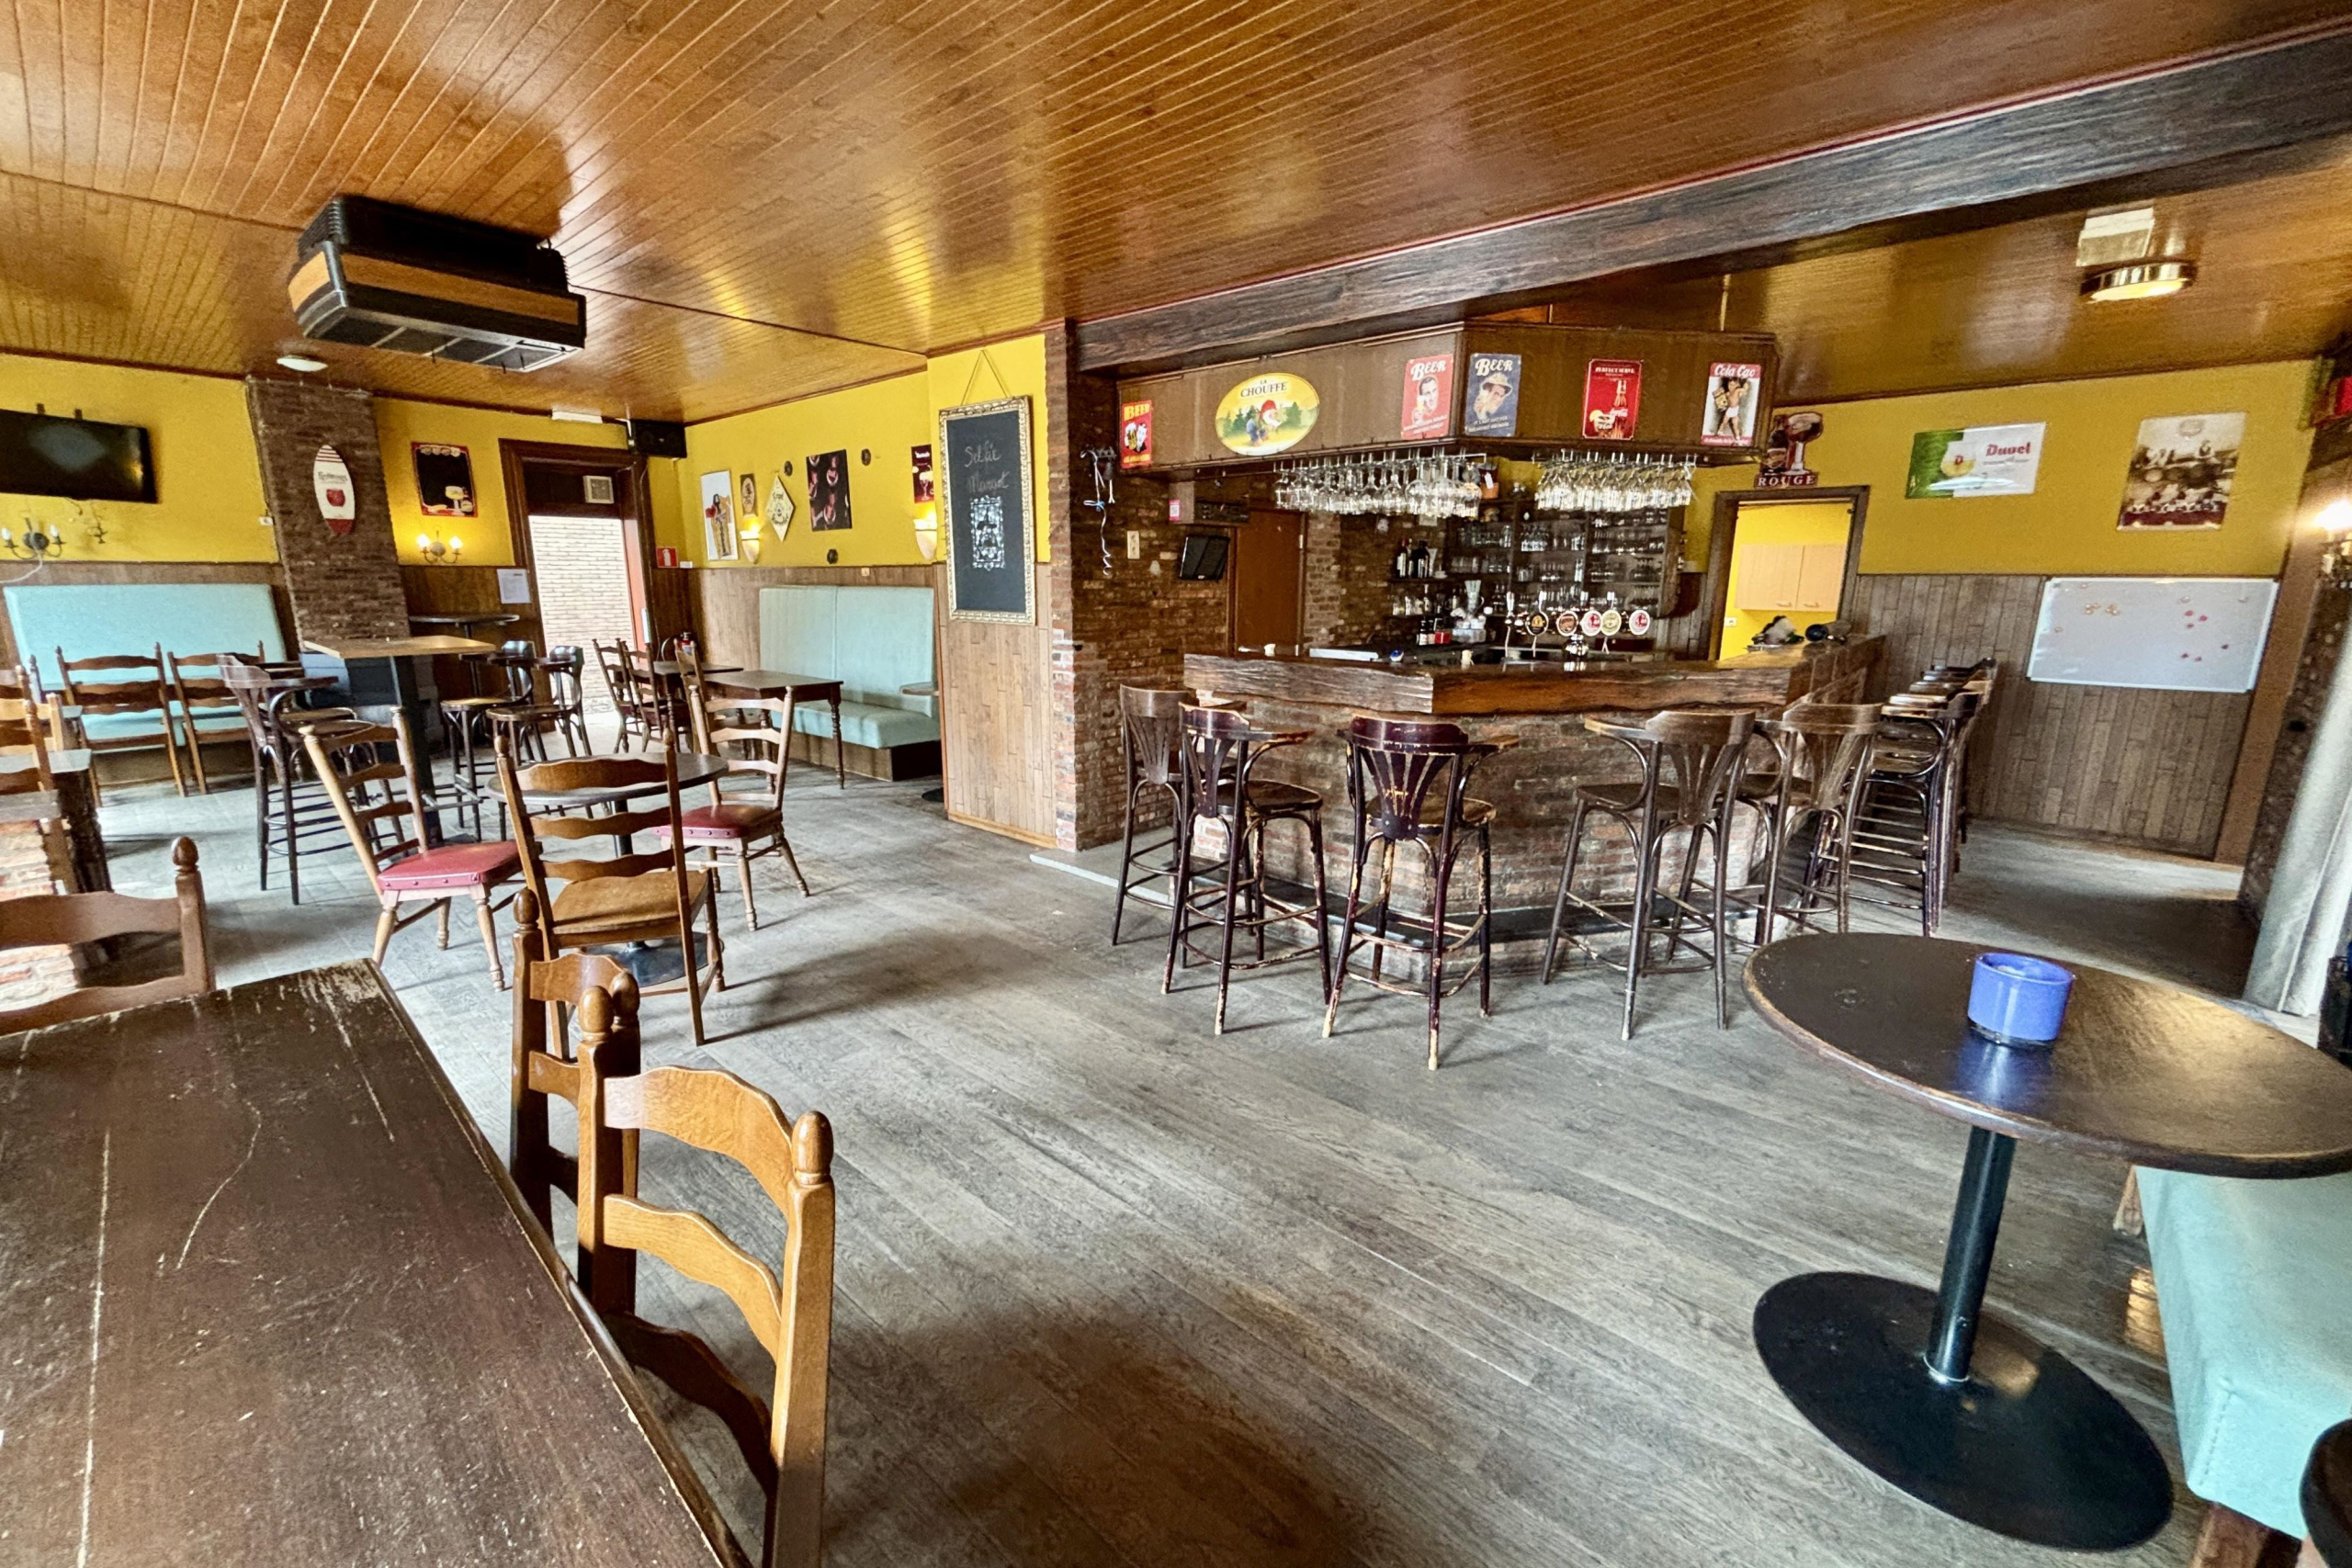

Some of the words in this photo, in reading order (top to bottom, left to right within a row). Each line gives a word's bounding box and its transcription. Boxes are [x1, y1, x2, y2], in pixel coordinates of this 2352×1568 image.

[1410, 360, 1447, 381] BEER
[1475, 358, 1513, 377] BEER
[1714, 364, 1736, 378] Cola
[1736, 365, 1756, 378] Cao
[1240, 382, 1287, 397] CHOUFFE
[1985, 441, 2031, 457] Duvel
[1758, 475, 1815, 487] ROUGE
